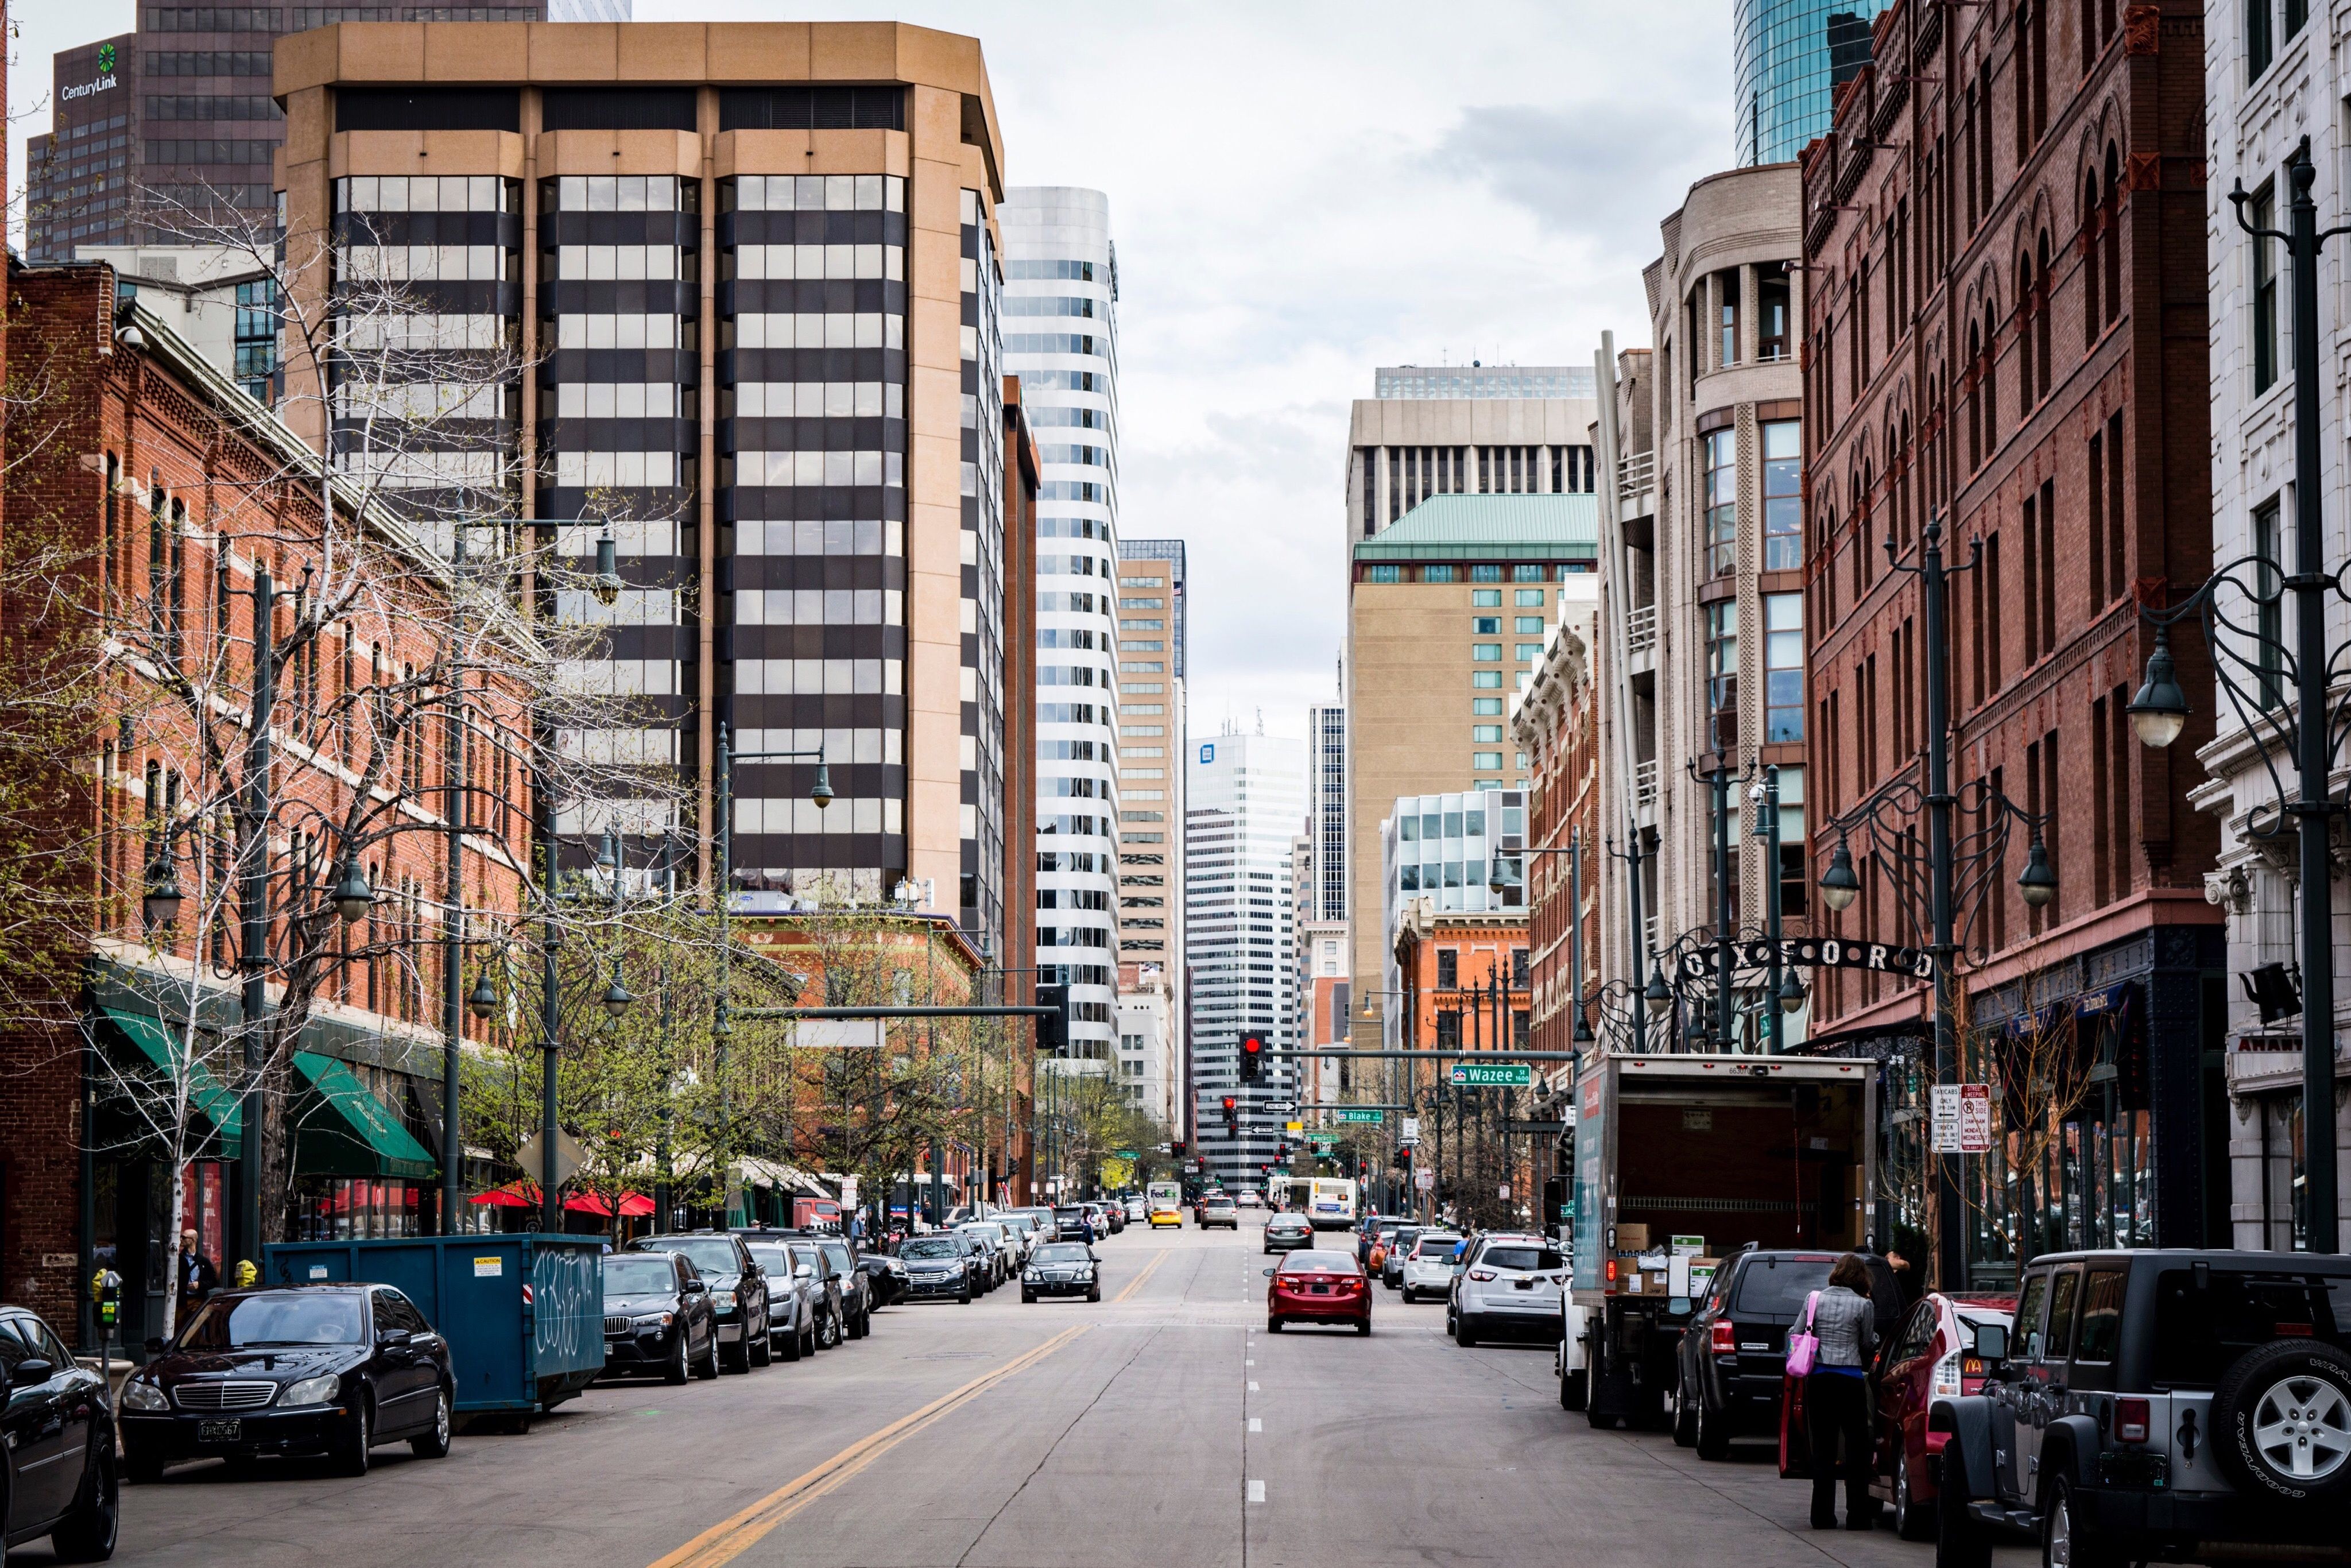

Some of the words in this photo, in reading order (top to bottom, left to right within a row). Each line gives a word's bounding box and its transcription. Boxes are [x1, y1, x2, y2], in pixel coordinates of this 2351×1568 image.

[62, 73, 117, 100] CenturyLink
[1686, 939, 1933, 977] OXFORD
[1469, 1068, 1513, 1082] Wazee
[1349, 1112, 1370, 1120] Blake
[1151, 1189, 1177, 1198] FedEx
[2310, 1358, 2351, 1385] WRA
[2237, 1412, 2306, 1498] GOODYEAR
